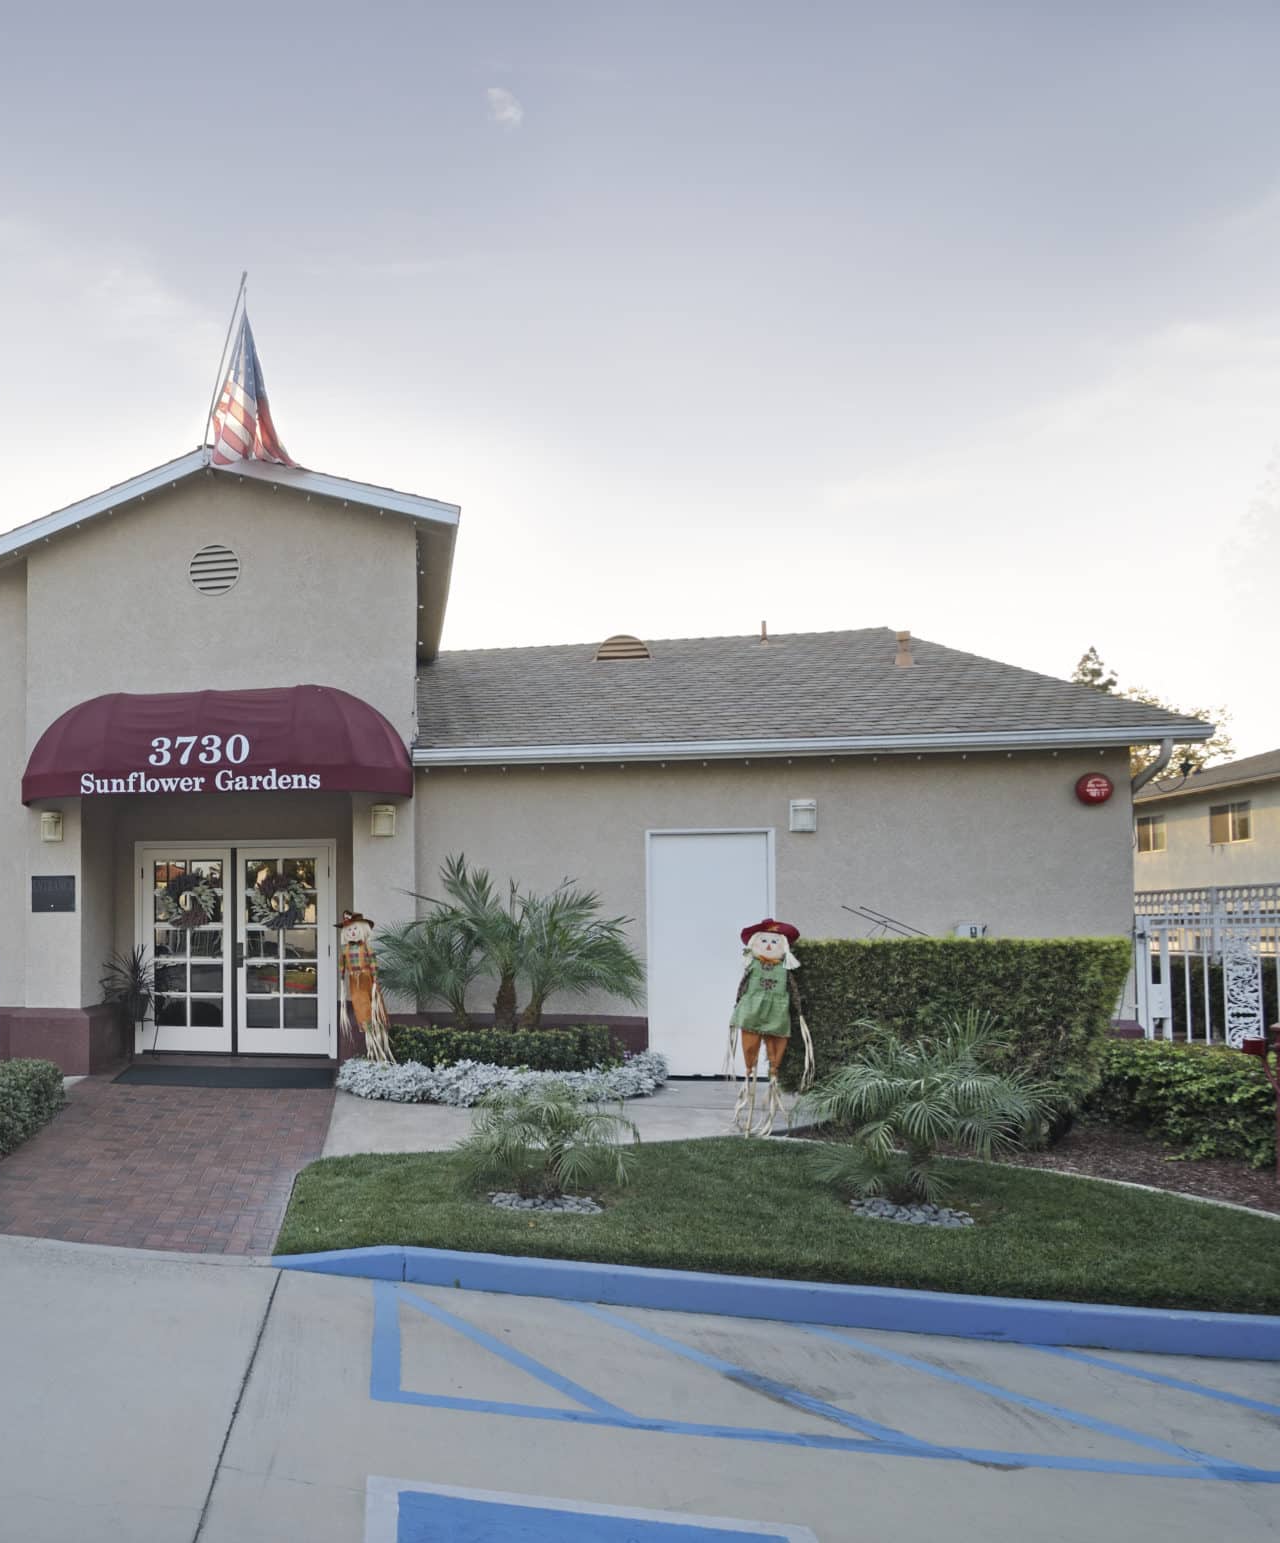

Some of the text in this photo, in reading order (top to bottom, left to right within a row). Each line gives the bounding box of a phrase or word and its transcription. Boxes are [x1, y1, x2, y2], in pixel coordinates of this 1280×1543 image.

[148, 734, 250, 766] 3730
[80, 768, 321, 794] Sunflower Gardens
